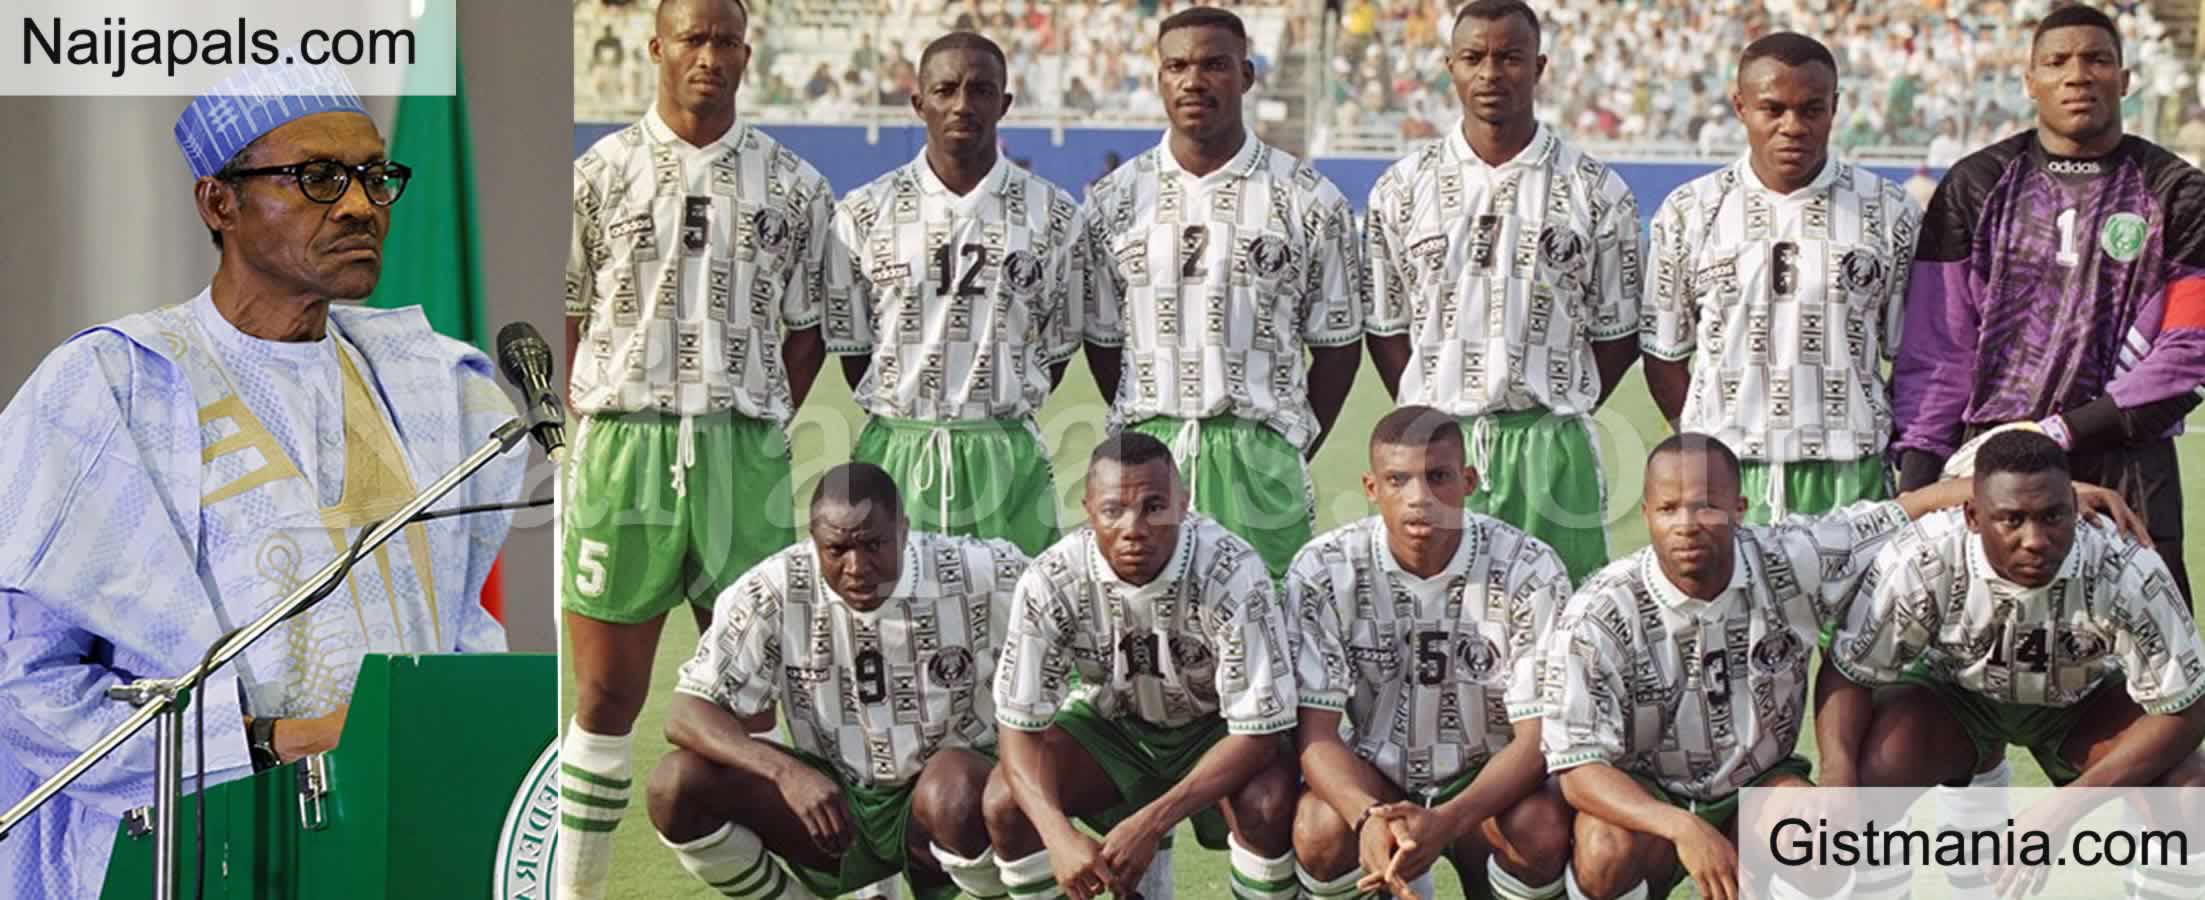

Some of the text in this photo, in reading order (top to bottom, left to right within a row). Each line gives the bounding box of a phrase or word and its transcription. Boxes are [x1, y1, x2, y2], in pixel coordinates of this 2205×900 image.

[2048, 160, 2100, 174] adidas
[683, 196, 712, 249] 5
[2056, 208, 2078, 266] 1
[935, 243, 986, 297] 12
[1183, 225, 1209, 277] 2
[1772, 242, 1799, 294] 6
[576, 538, 608, 598] 5
[1118, 633, 1165, 681] 11
[1986, 622, 2048, 673] 14
[855, 649, 886, 703] 9
[1704, 650, 1731, 705] 3
